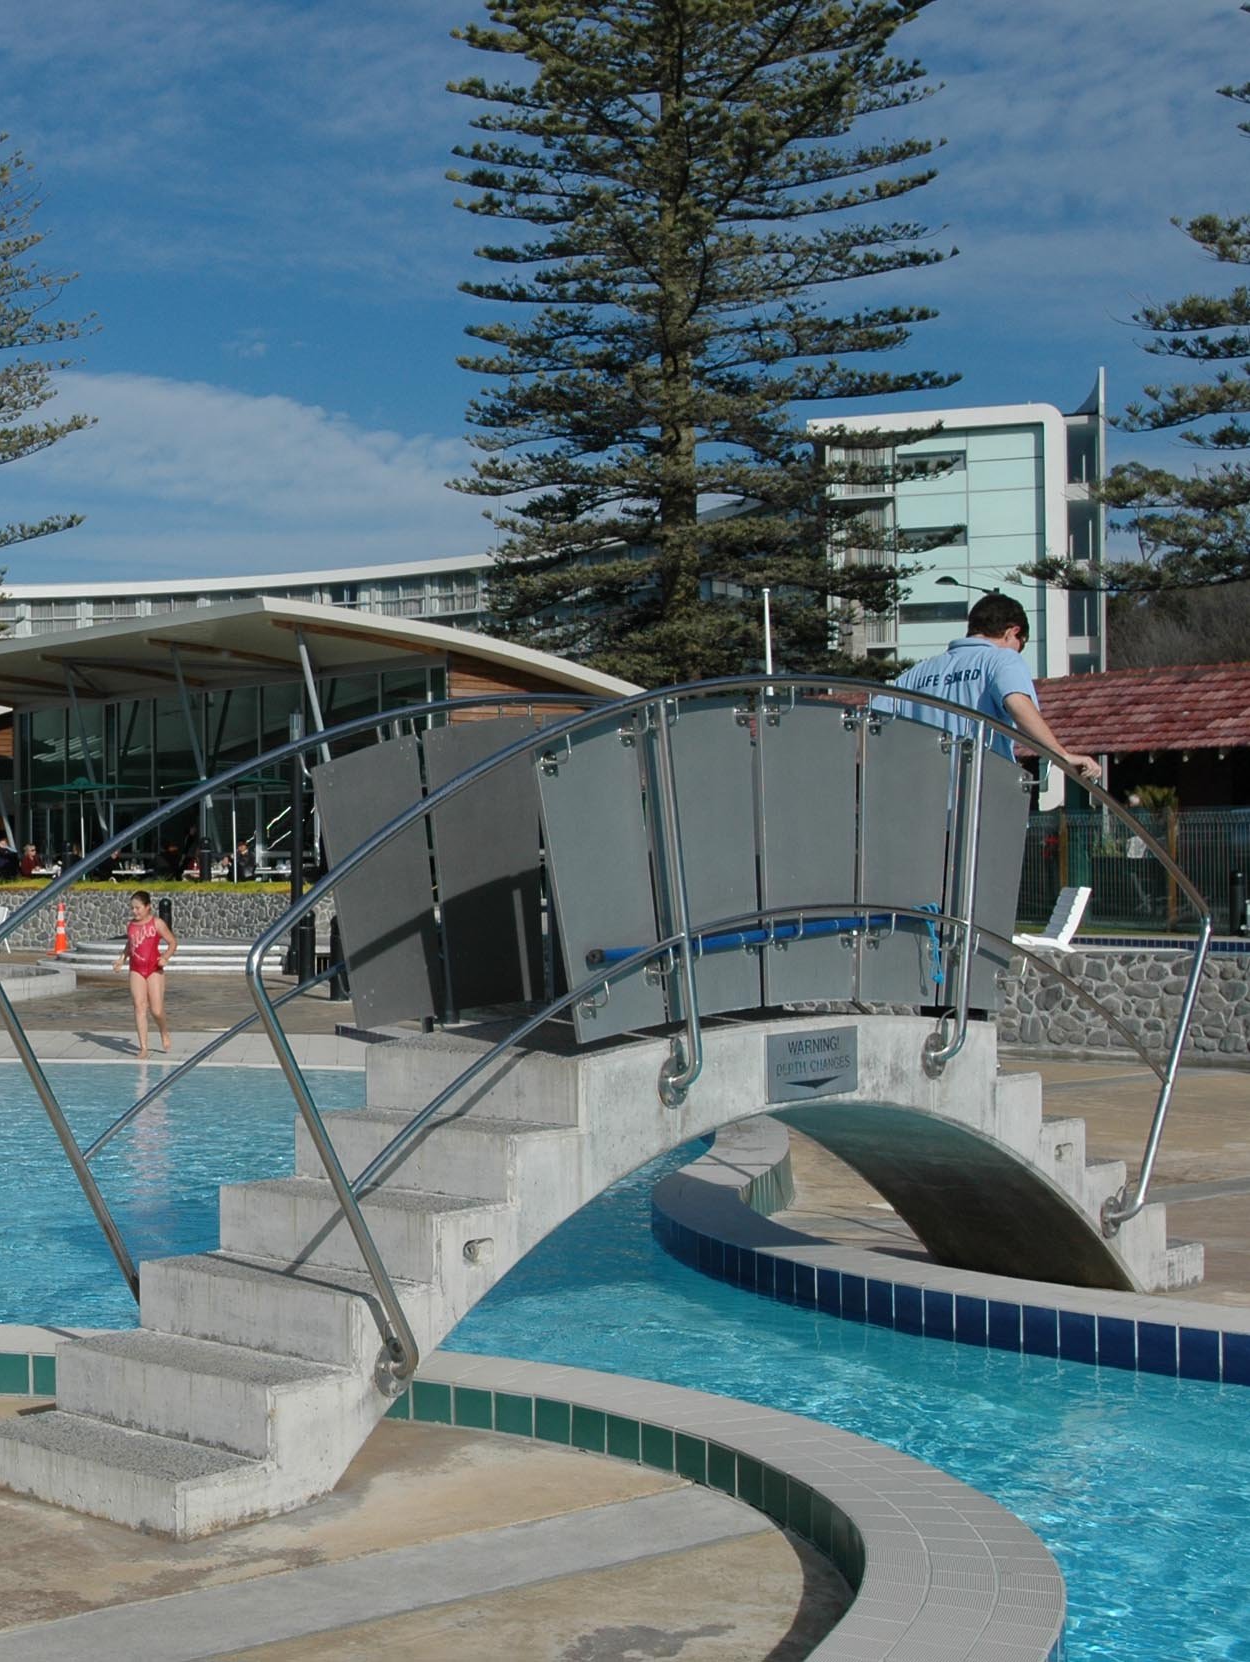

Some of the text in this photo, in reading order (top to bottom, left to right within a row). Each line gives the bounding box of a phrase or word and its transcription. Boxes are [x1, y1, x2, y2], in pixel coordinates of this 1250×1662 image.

[917, 673, 940, 689] LIFE
[788, 1035, 840, 1055] WARNING!
[776, 1055, 852, 1077] DEPTH CHANGES
